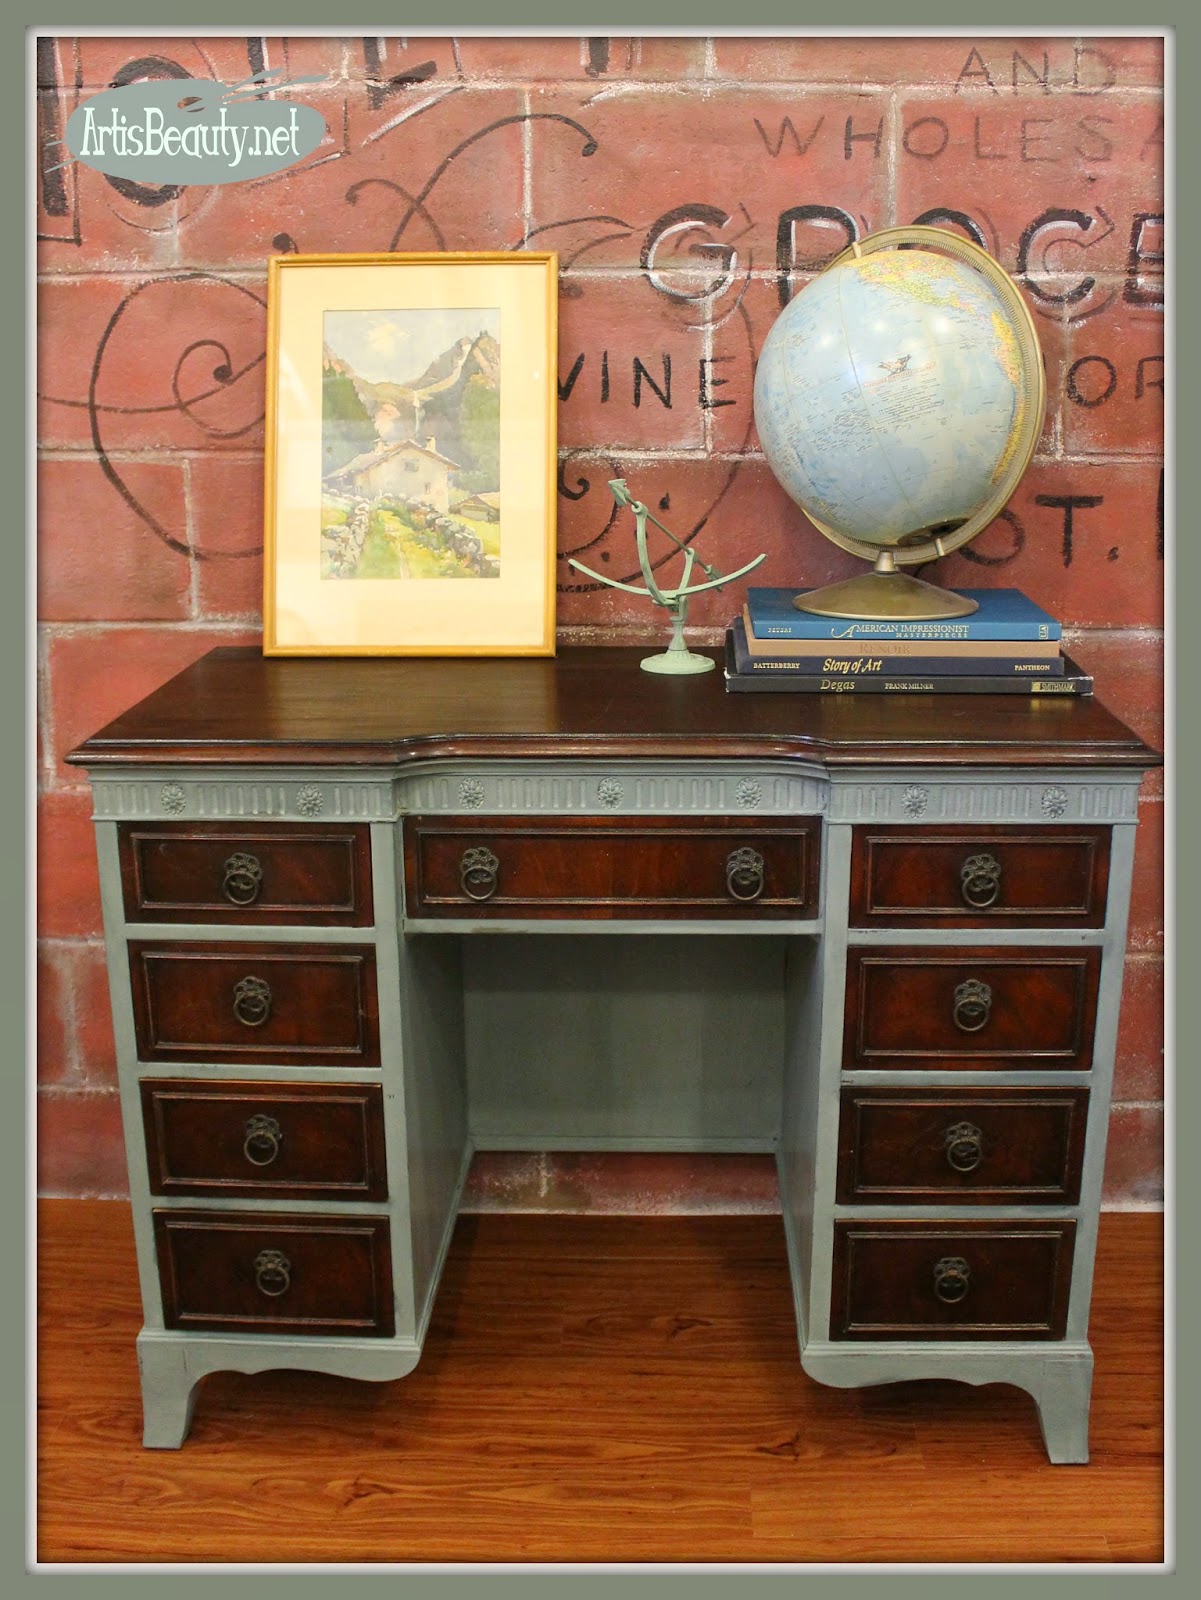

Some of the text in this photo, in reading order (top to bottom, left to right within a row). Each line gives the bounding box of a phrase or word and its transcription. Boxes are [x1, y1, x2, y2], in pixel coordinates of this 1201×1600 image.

[954, 46, 1116, 96] AND
[830, 624, 969, 638] AMERICAN IMPRESSIONIST
[859, 643, 911, 655] RENOIR
[822, 658, 882, 674] Story of Art
[820, 679, 855, 692] Degas
[884, 682, 934, 690] FRANK MILNER
